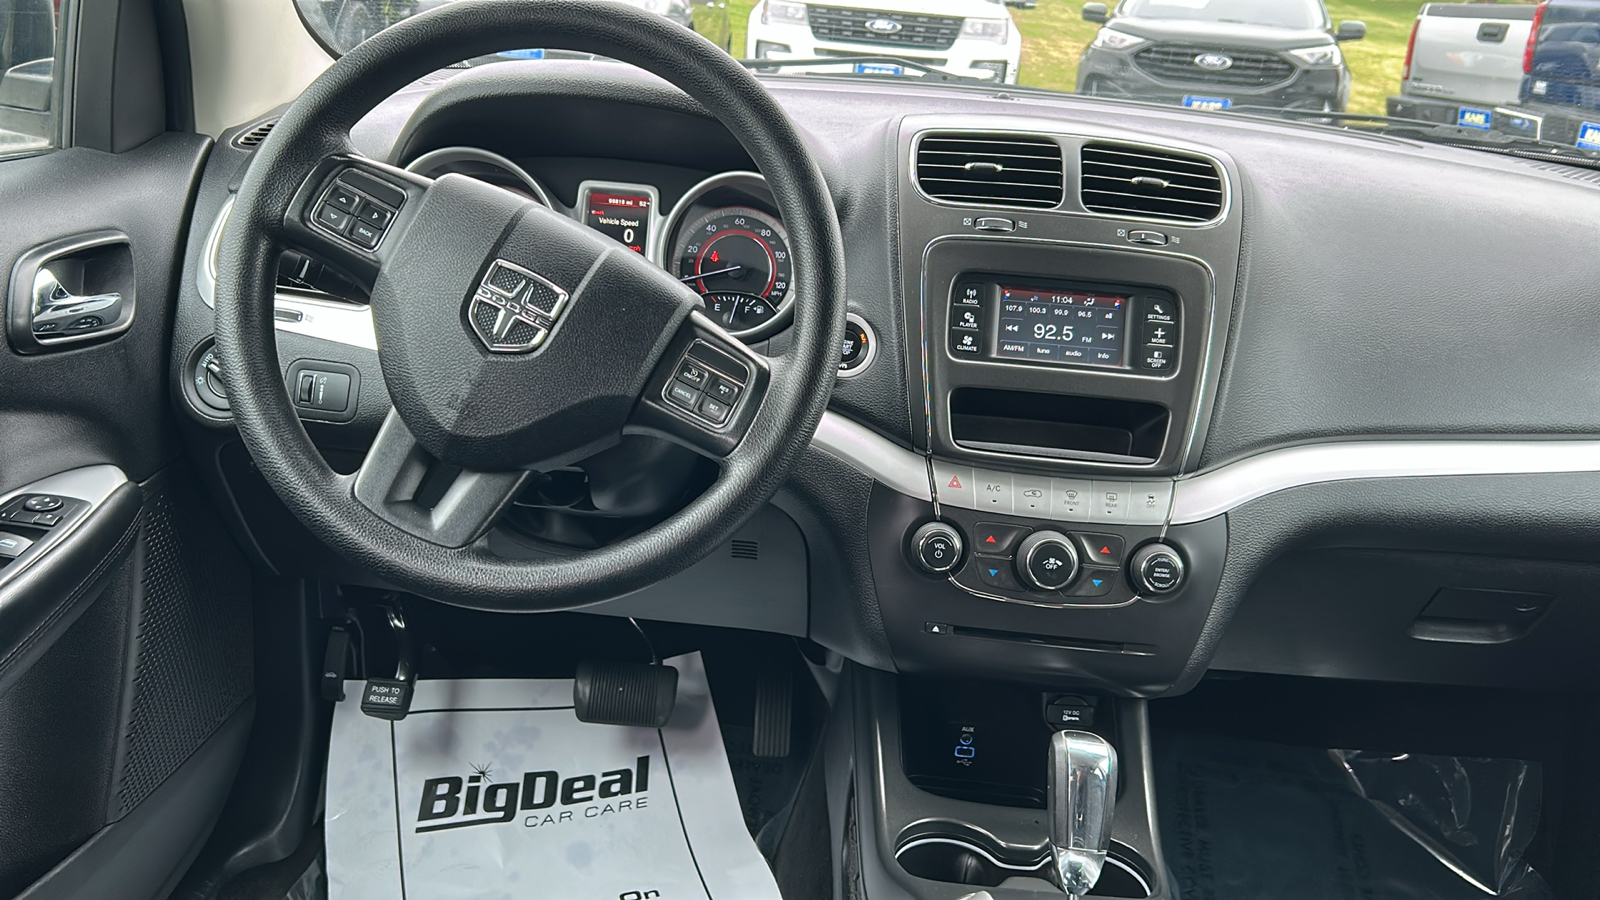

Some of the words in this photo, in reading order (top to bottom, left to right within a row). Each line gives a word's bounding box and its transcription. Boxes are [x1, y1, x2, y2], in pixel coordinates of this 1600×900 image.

[599, 217, 619, 226] Vehicle
[620, 218, 639, 227] Speed
[359, 227, 373, 238] BACK
[623, 228, 634, 243] 0
[760, 229, 771, 237] 80
[775, 251, 786, 259] 100
[775, 282, 786, 290] 120
[1051, 296, 1073, 304] 11:04
[714, 303, 721, 311] E
[744, 306, 751, 314] F
[1033, 323, 1074, 342] 92.5
[1003, 344, 1024, 352] AM/FM
[201, 353, 214, 368] AUTO
[719, 384, 730, 393] RES
[674, 387, 692, 399] CANCEL
[708, 403, 719, 411] SET
[986, 484, 1001, 492] A/C
[372, 686, 390, 694] PUSH
[369, 695, 398, 704] RELEASE
[415, 755, 650, 833] BigDeal
[524, 810, 573, 828] CAR
[584, 797, 649, 818] CARE
